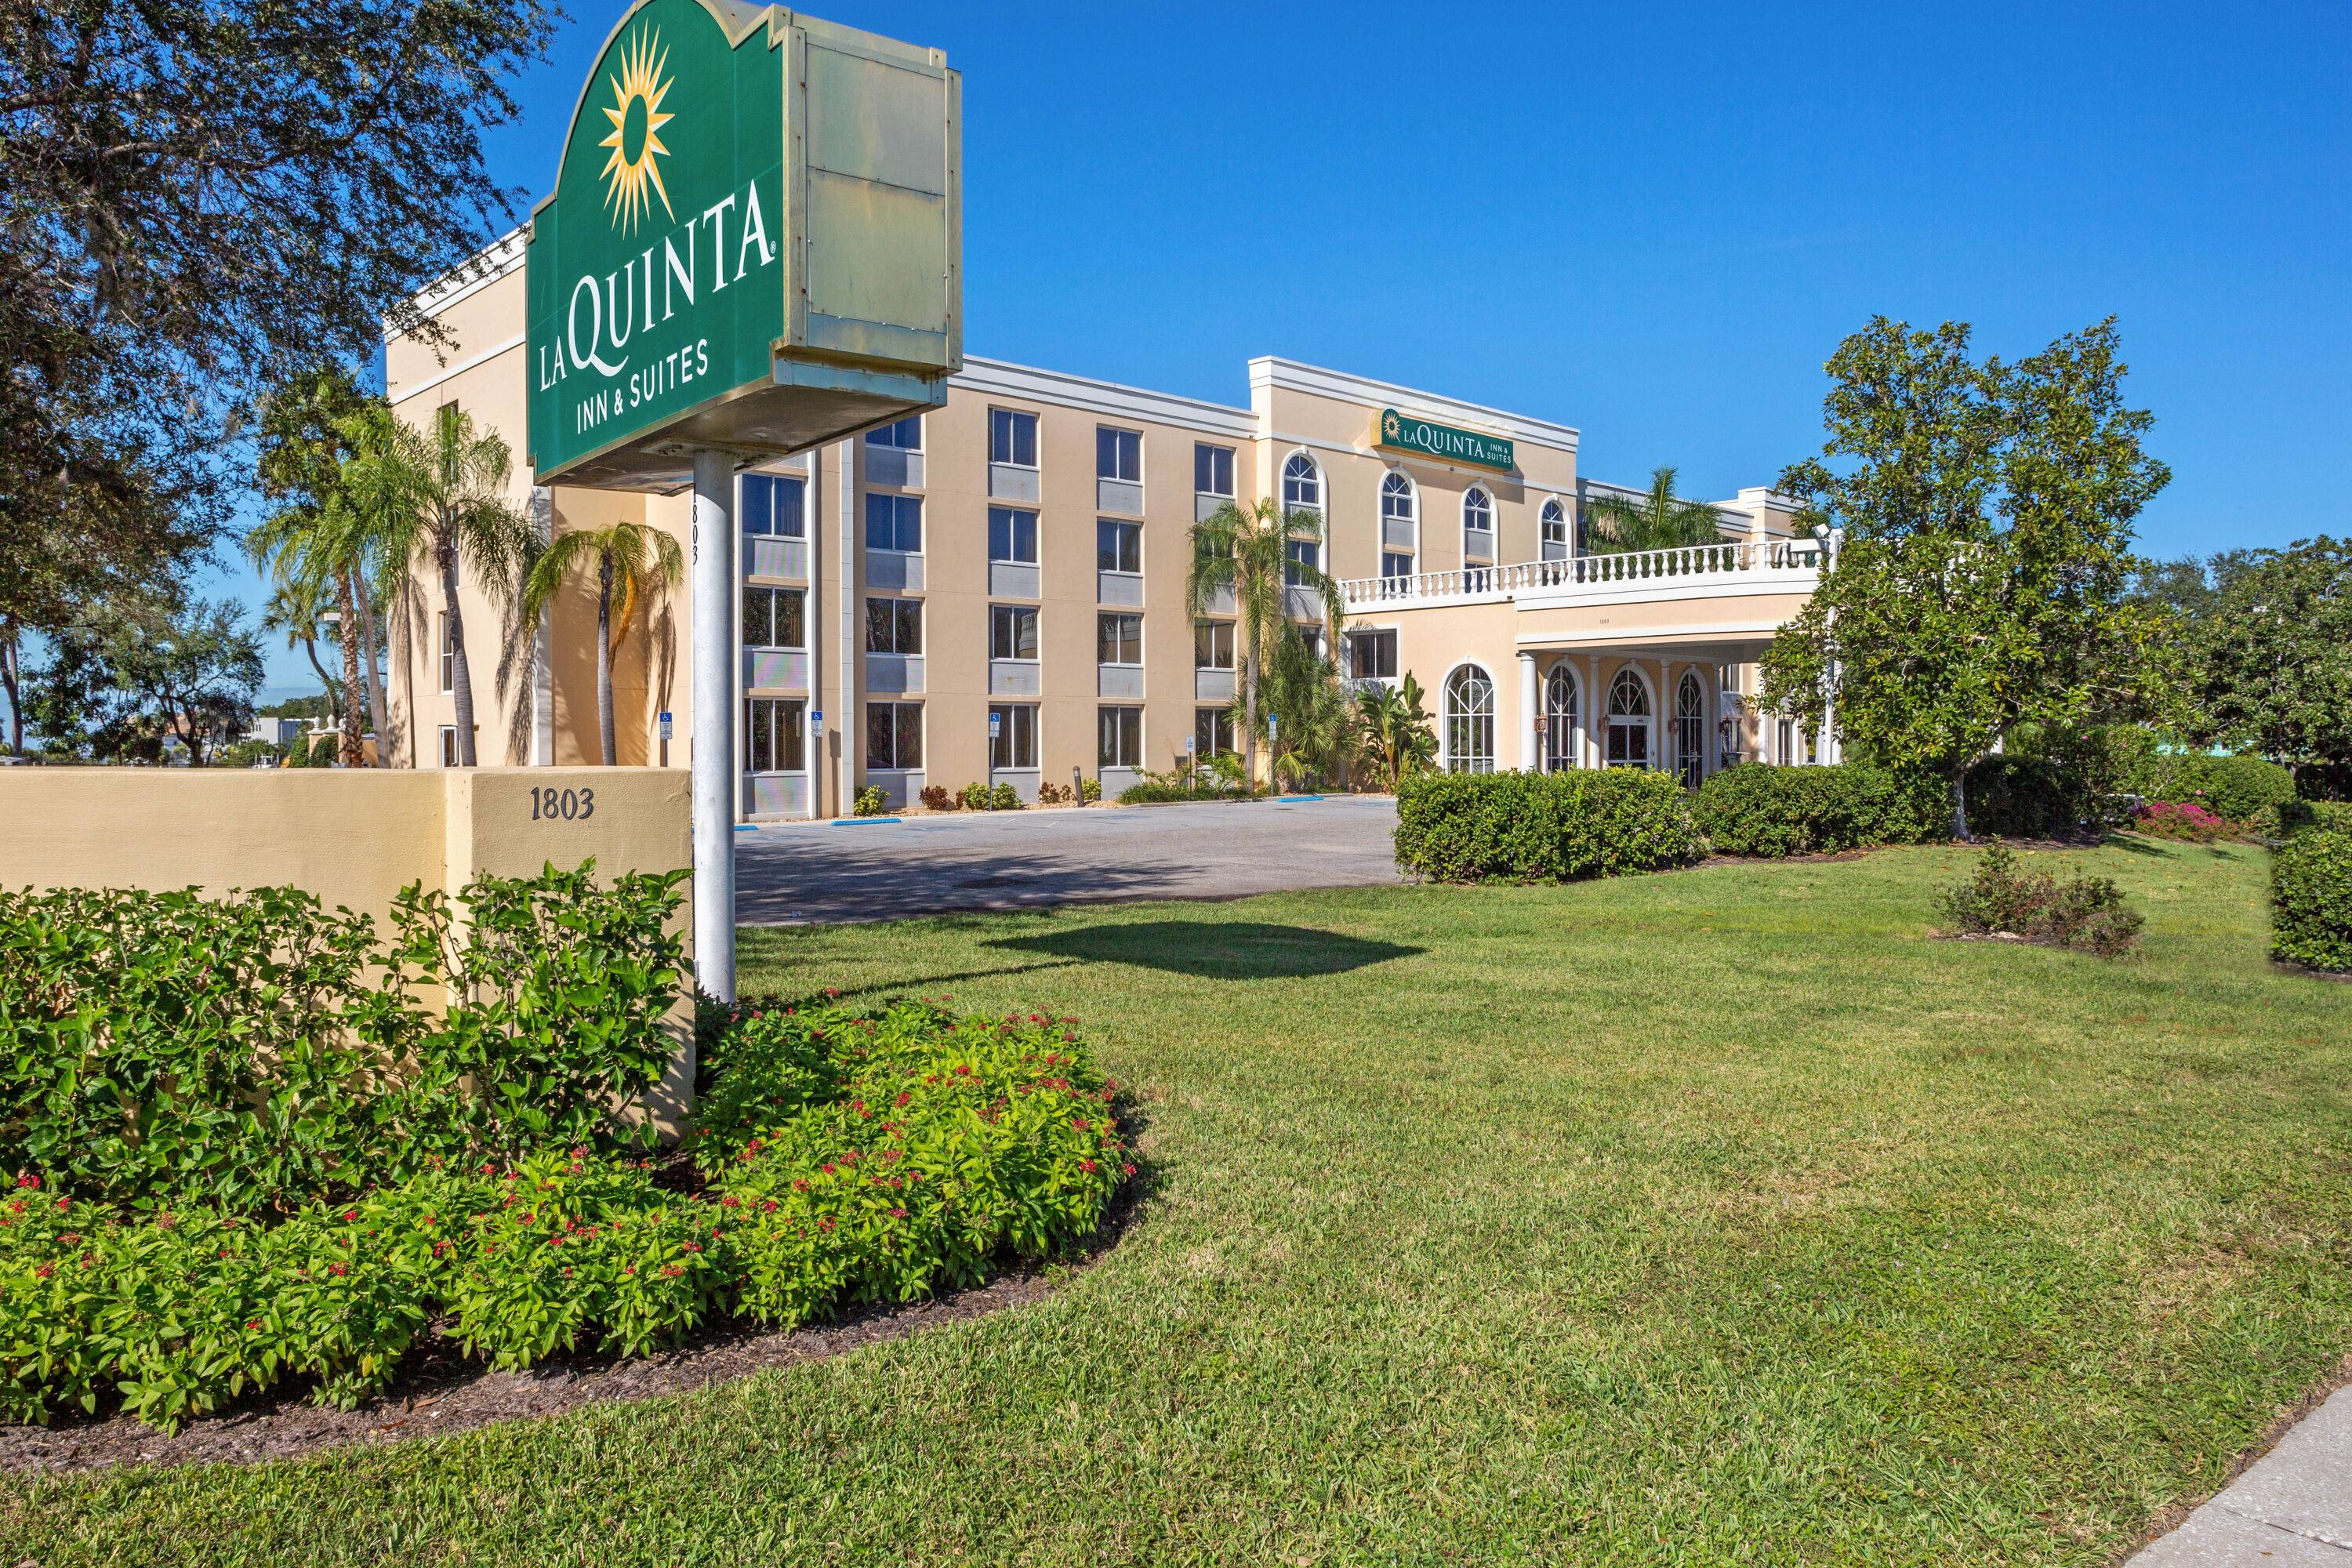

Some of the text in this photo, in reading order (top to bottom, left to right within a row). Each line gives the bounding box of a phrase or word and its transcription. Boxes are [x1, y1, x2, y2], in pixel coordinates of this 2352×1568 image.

[539, 335, 568, 393] LA
[577, 338, 709, 435] INN & SUITES
[1403, 430, 1417, 445] LA
[1490, 443, 1504, 453] INN
[1486, 451, 1512, 464] SUITES
[531, 786, 594, 821] 1803
